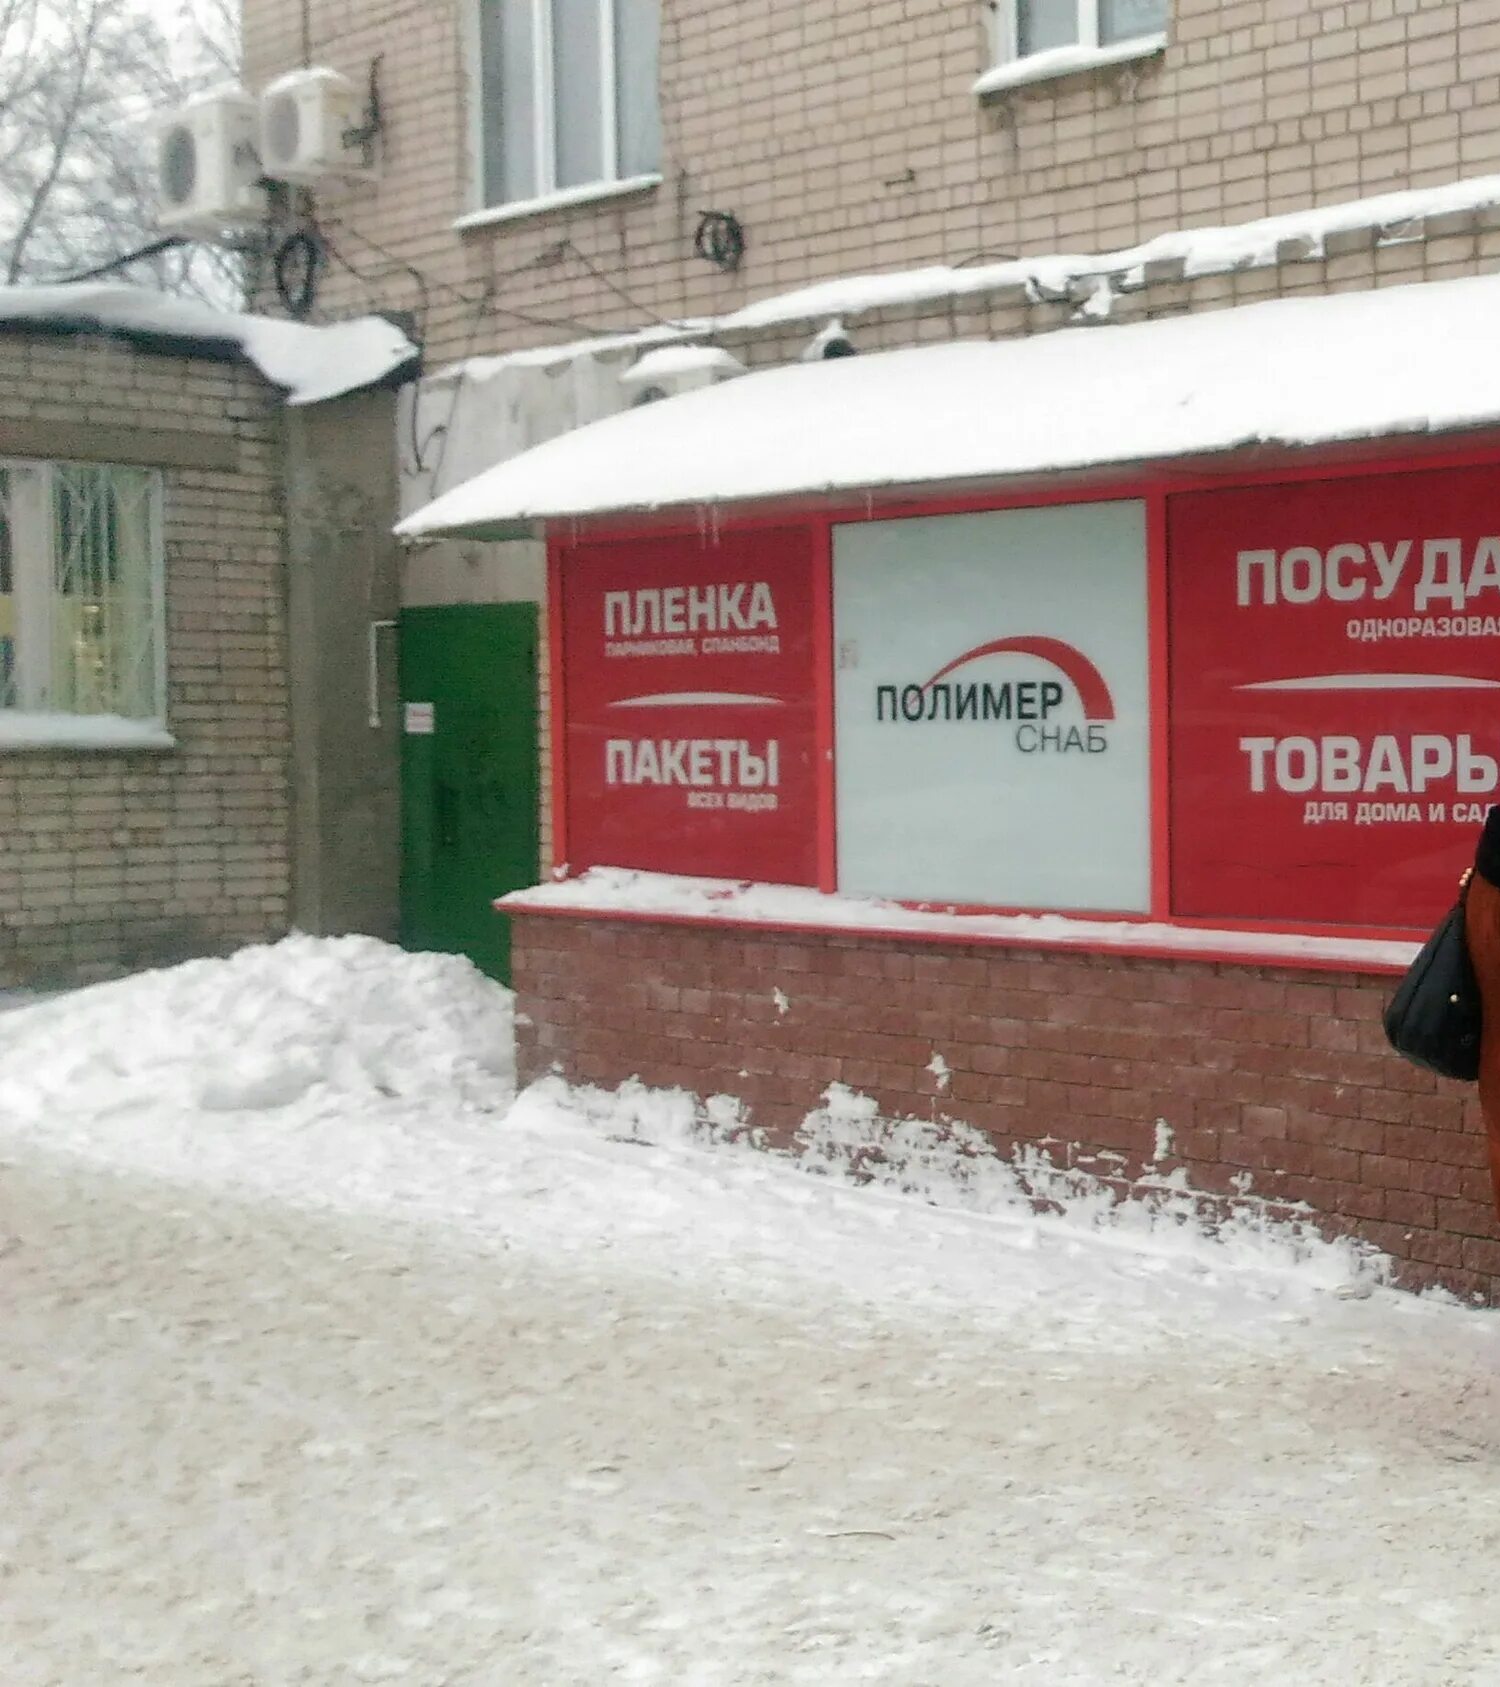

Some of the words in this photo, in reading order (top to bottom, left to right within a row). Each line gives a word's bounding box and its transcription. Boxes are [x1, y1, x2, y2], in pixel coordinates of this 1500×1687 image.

[604, 582, 778, 637] ПЛЕНКА
[876, 681, 1064, 722] ПОЛИМЕР
[1014, 723, 1109, 753] СНАБ
[605, 739, 779, 787] ПАКЕТЫ
[1303, 801, 1348, 825] ДЛЯ
[1355, 801, 1422, 825] ДОМА
[1428, 802, 1445, 823] И
